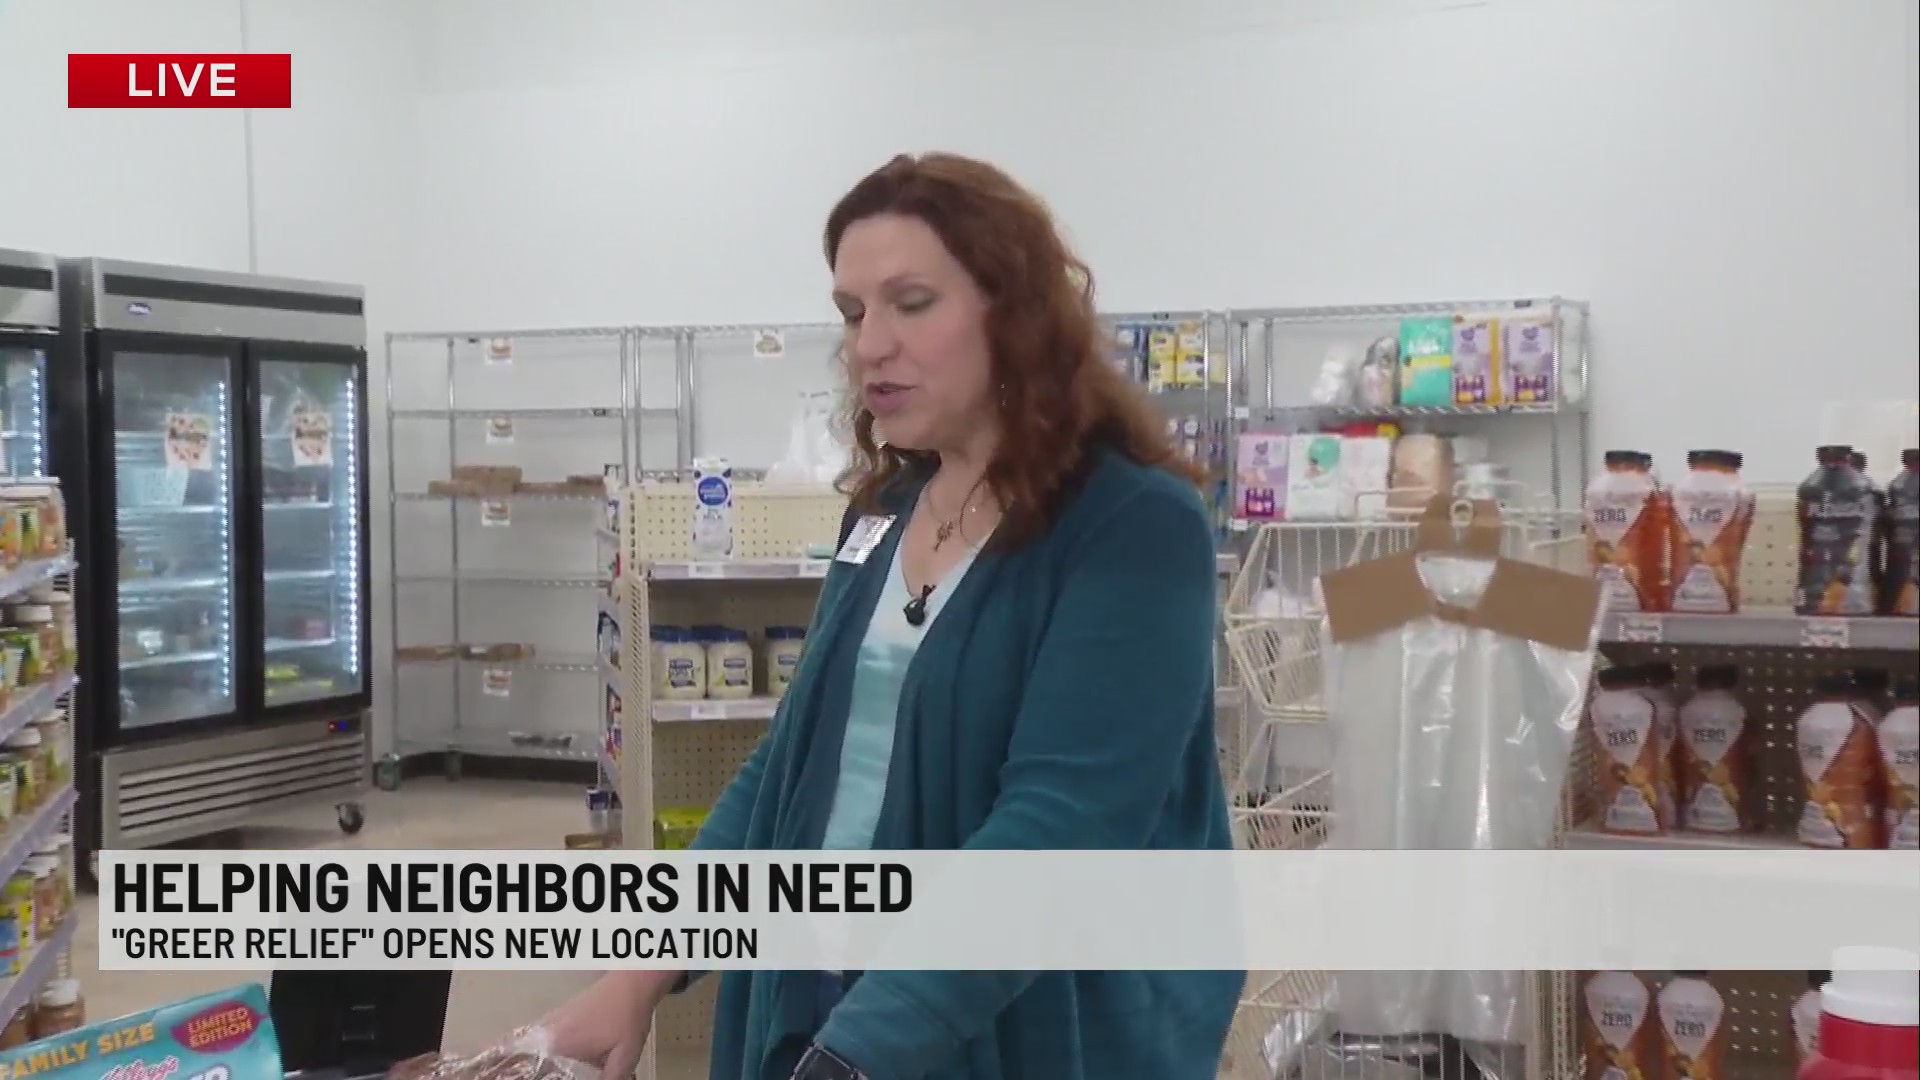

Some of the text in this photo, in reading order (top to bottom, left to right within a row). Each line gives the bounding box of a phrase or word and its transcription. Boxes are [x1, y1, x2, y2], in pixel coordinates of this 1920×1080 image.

[188, 1006, 249, 1034] LIMITED
[190, 1017, 253, 1048] EDITION
[1602, 1010, 1633, 1029] ZERO
[1675, 1018, 1706, 1038] ZERO
[0, 1021, 155, 1079] FAMILY SIZE
